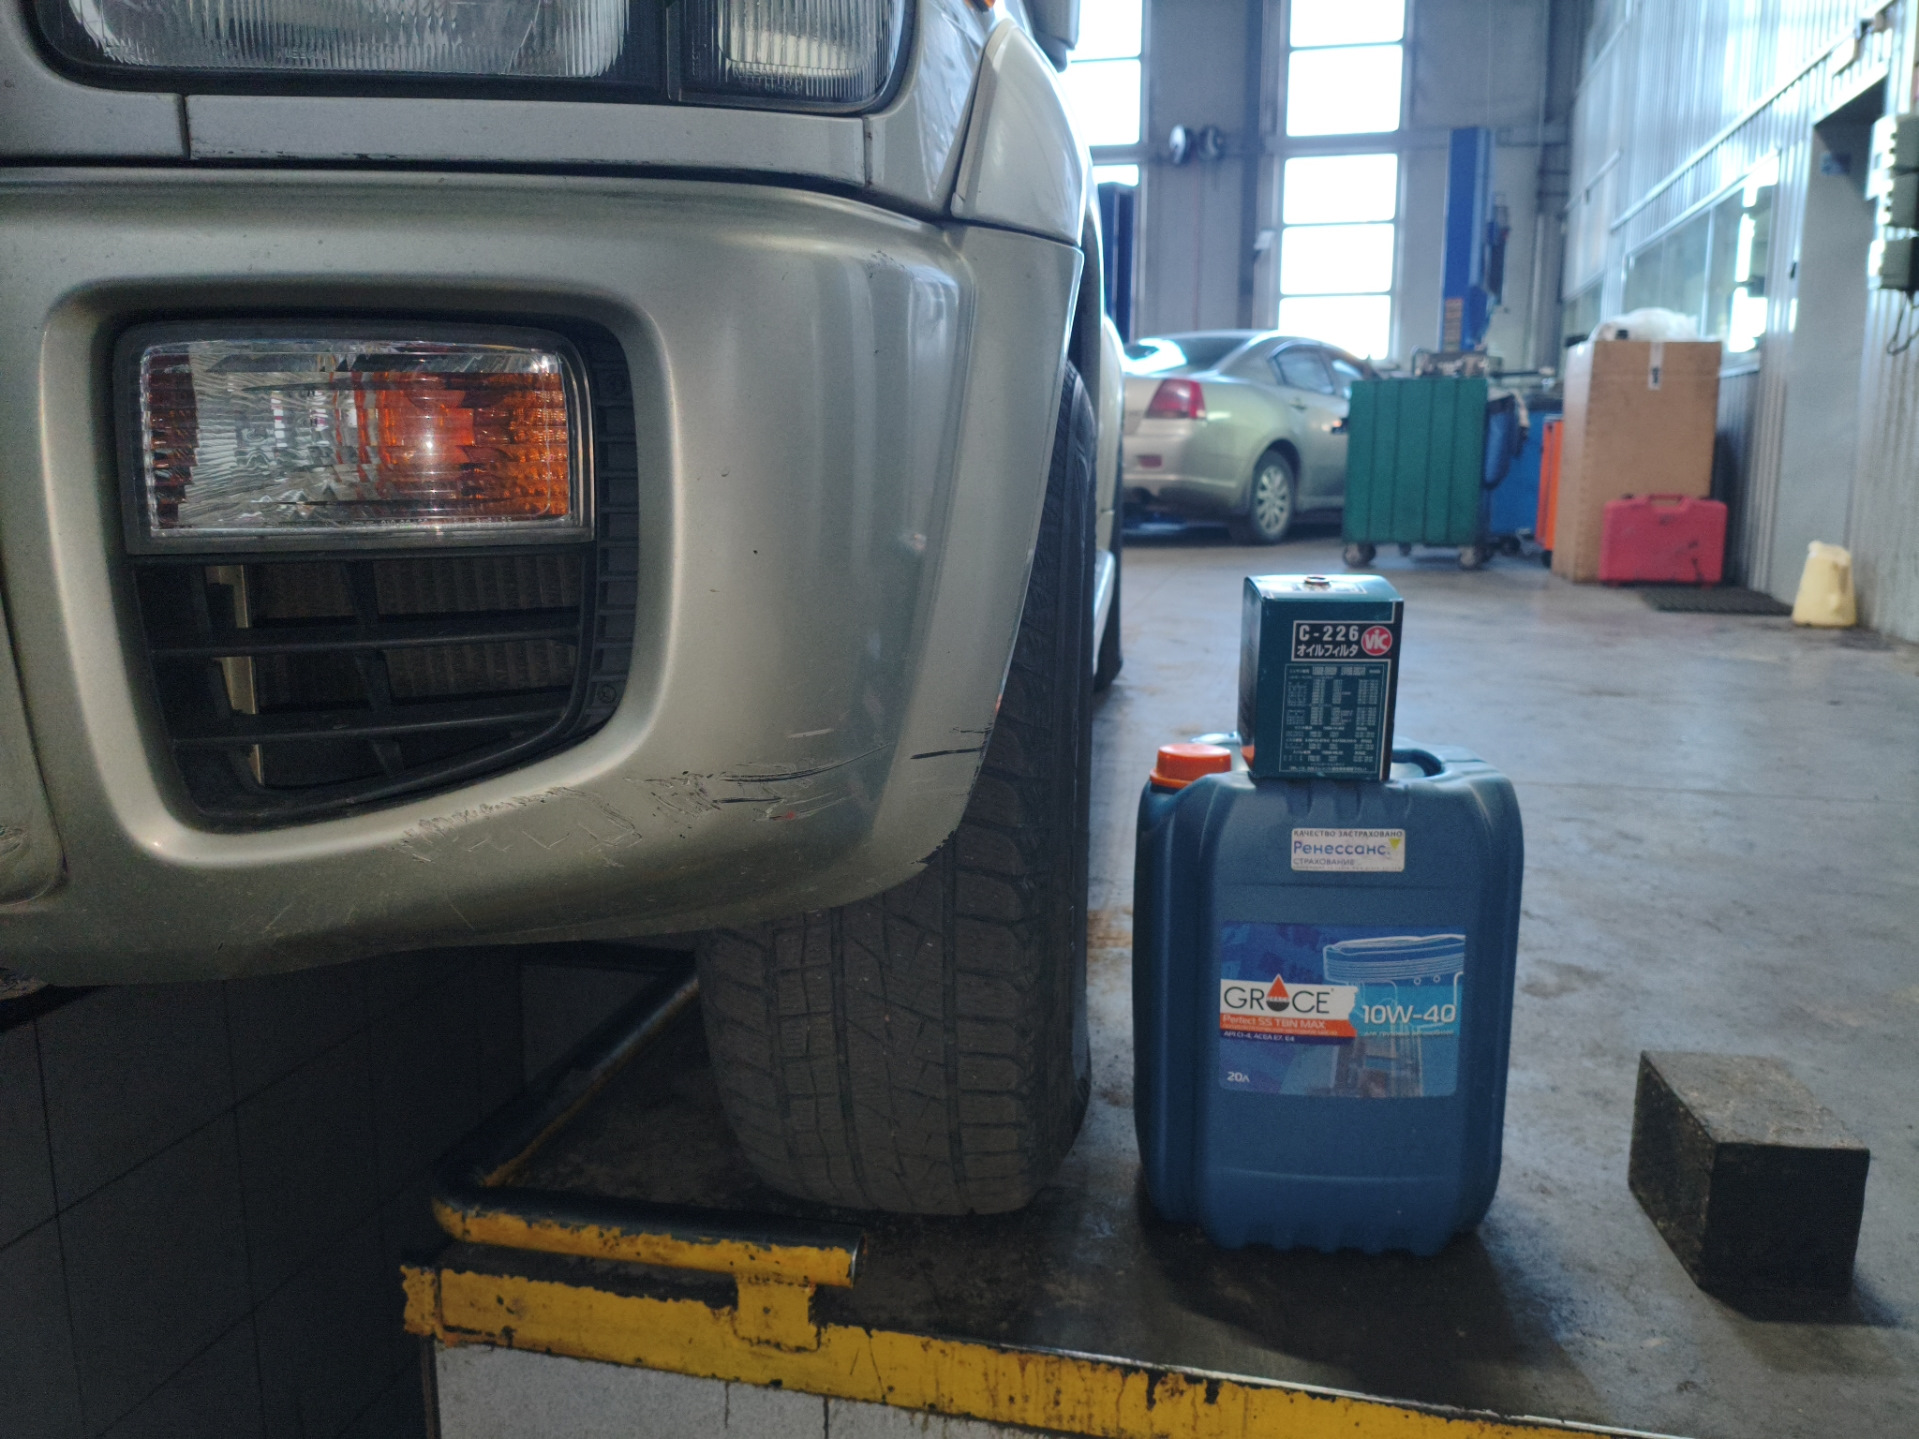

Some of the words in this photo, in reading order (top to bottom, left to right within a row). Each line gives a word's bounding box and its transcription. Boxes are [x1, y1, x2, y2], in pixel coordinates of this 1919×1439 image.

[1299, 625, 1359, 641] C-226
[1297, 644, 1359, 657] オイルフィルタ
[1293, 830, 1336, 838] КАЧЕСТВО
[1338, 830, 1403, 838] ЗАСТРАХОВАНО
[1293, 841, 1386, 855] Ренессанс
[1293, 858, 1355, 866] СТРАХОВАНИЕ
[1362, 1004, 1456, 1024] 10W-40
[1222, 1014, 1256, 1026] Perfect
[1300, 1019, 1325, 1030] MAX
